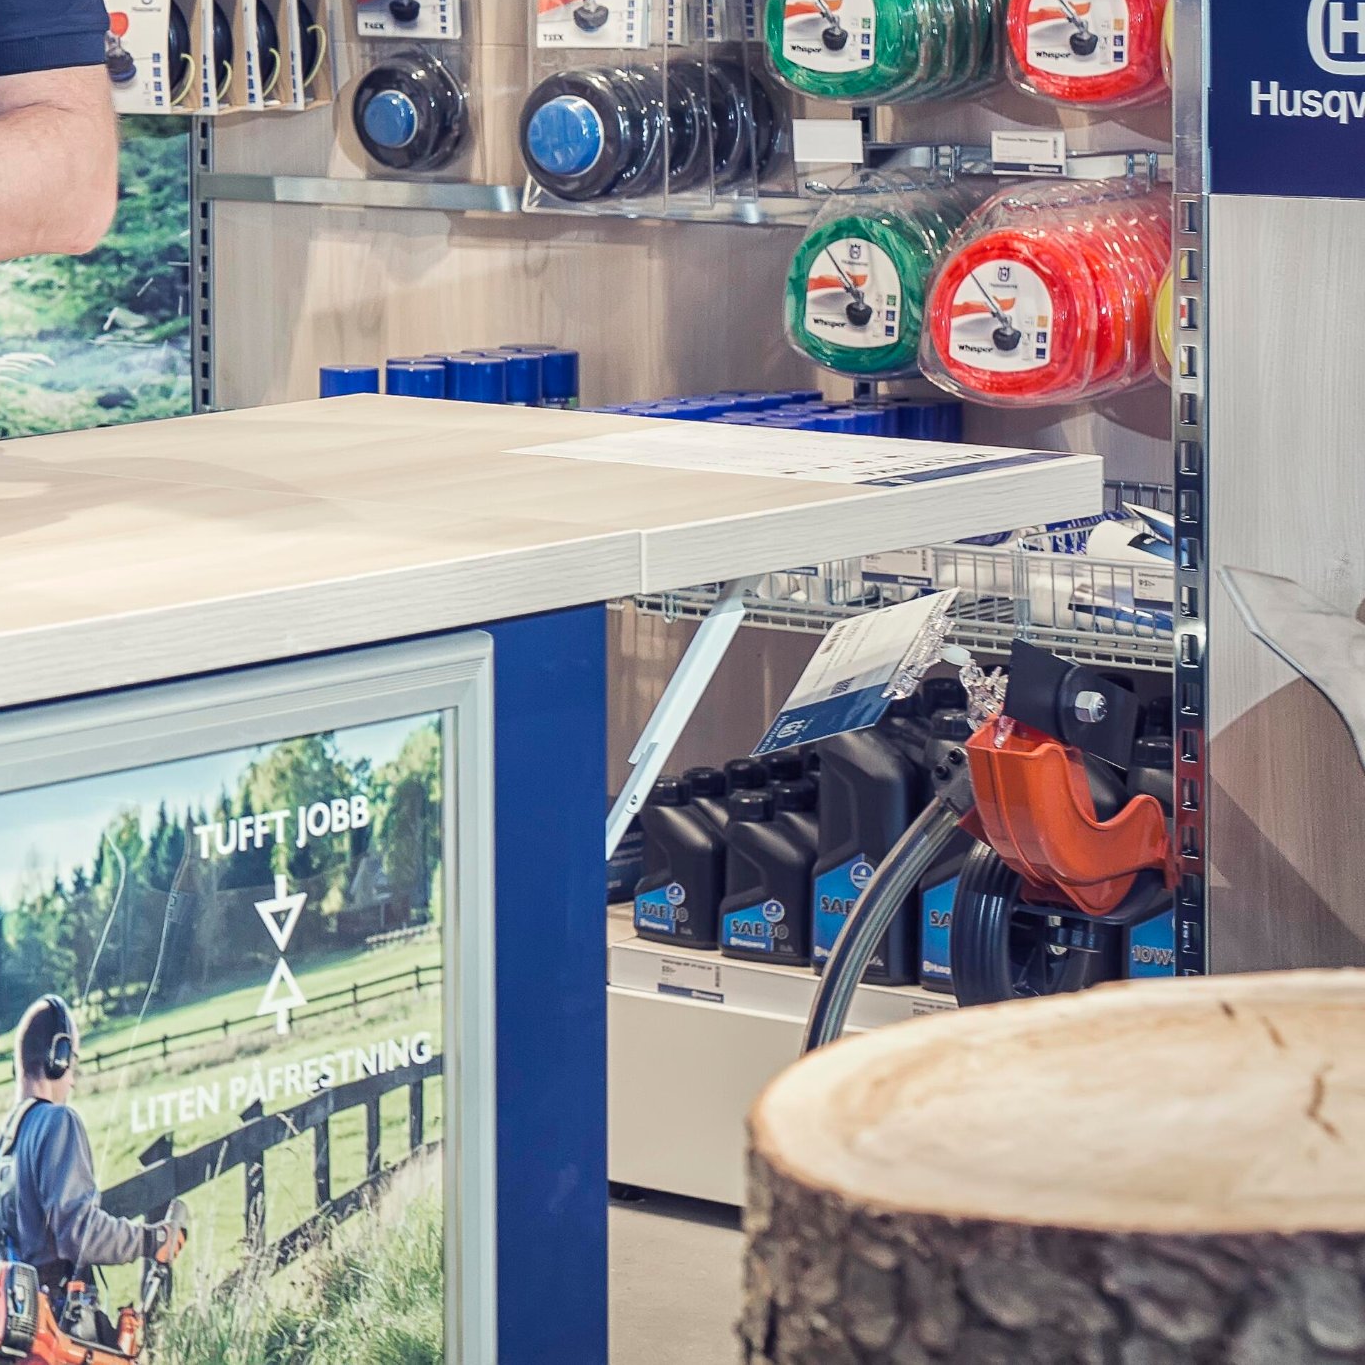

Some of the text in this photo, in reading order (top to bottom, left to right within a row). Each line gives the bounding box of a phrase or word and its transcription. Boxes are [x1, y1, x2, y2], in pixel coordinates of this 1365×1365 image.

[193, 795, 370, 859] TUFFT JOBB
[640, 899, 667, 919] SAE
[731, 919, 763, 936] SAE
[131, 1032, 433, 1134] LITEN PÅFRESTNING
